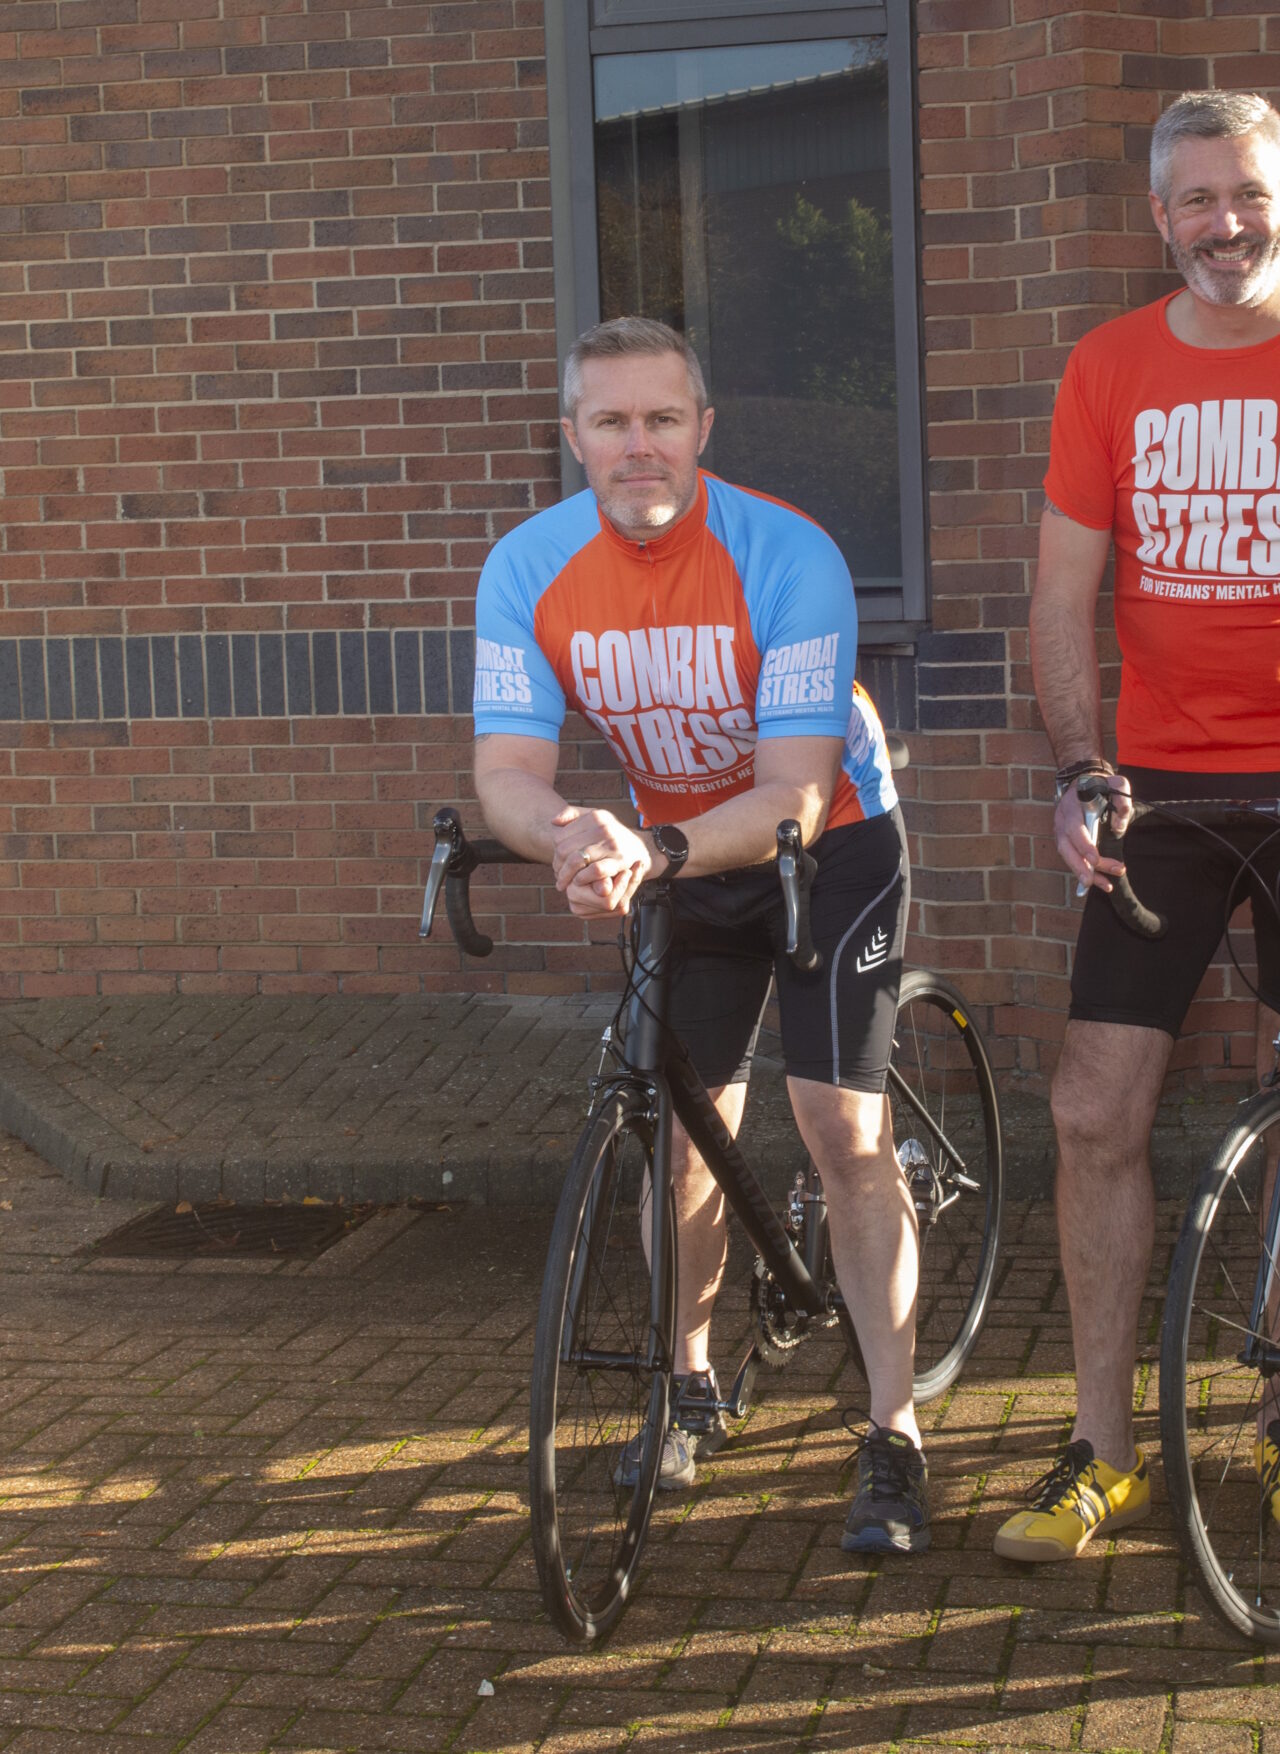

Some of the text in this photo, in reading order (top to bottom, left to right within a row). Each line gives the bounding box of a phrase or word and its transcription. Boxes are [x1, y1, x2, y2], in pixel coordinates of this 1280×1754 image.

[1139, 575, 1154, 592] FOR
[1216, 584, 1270, 600] MENTAL
[571, 625, 744, 712] COMBAT
[763, 632, 840, 677] COMBAT
[474, 669, 532, 704] TRESS
[760, 667, 835, 708] STRESS
[585, 707, 758, 776] STRESS
[690, 775, 736, 794] MENTAL
